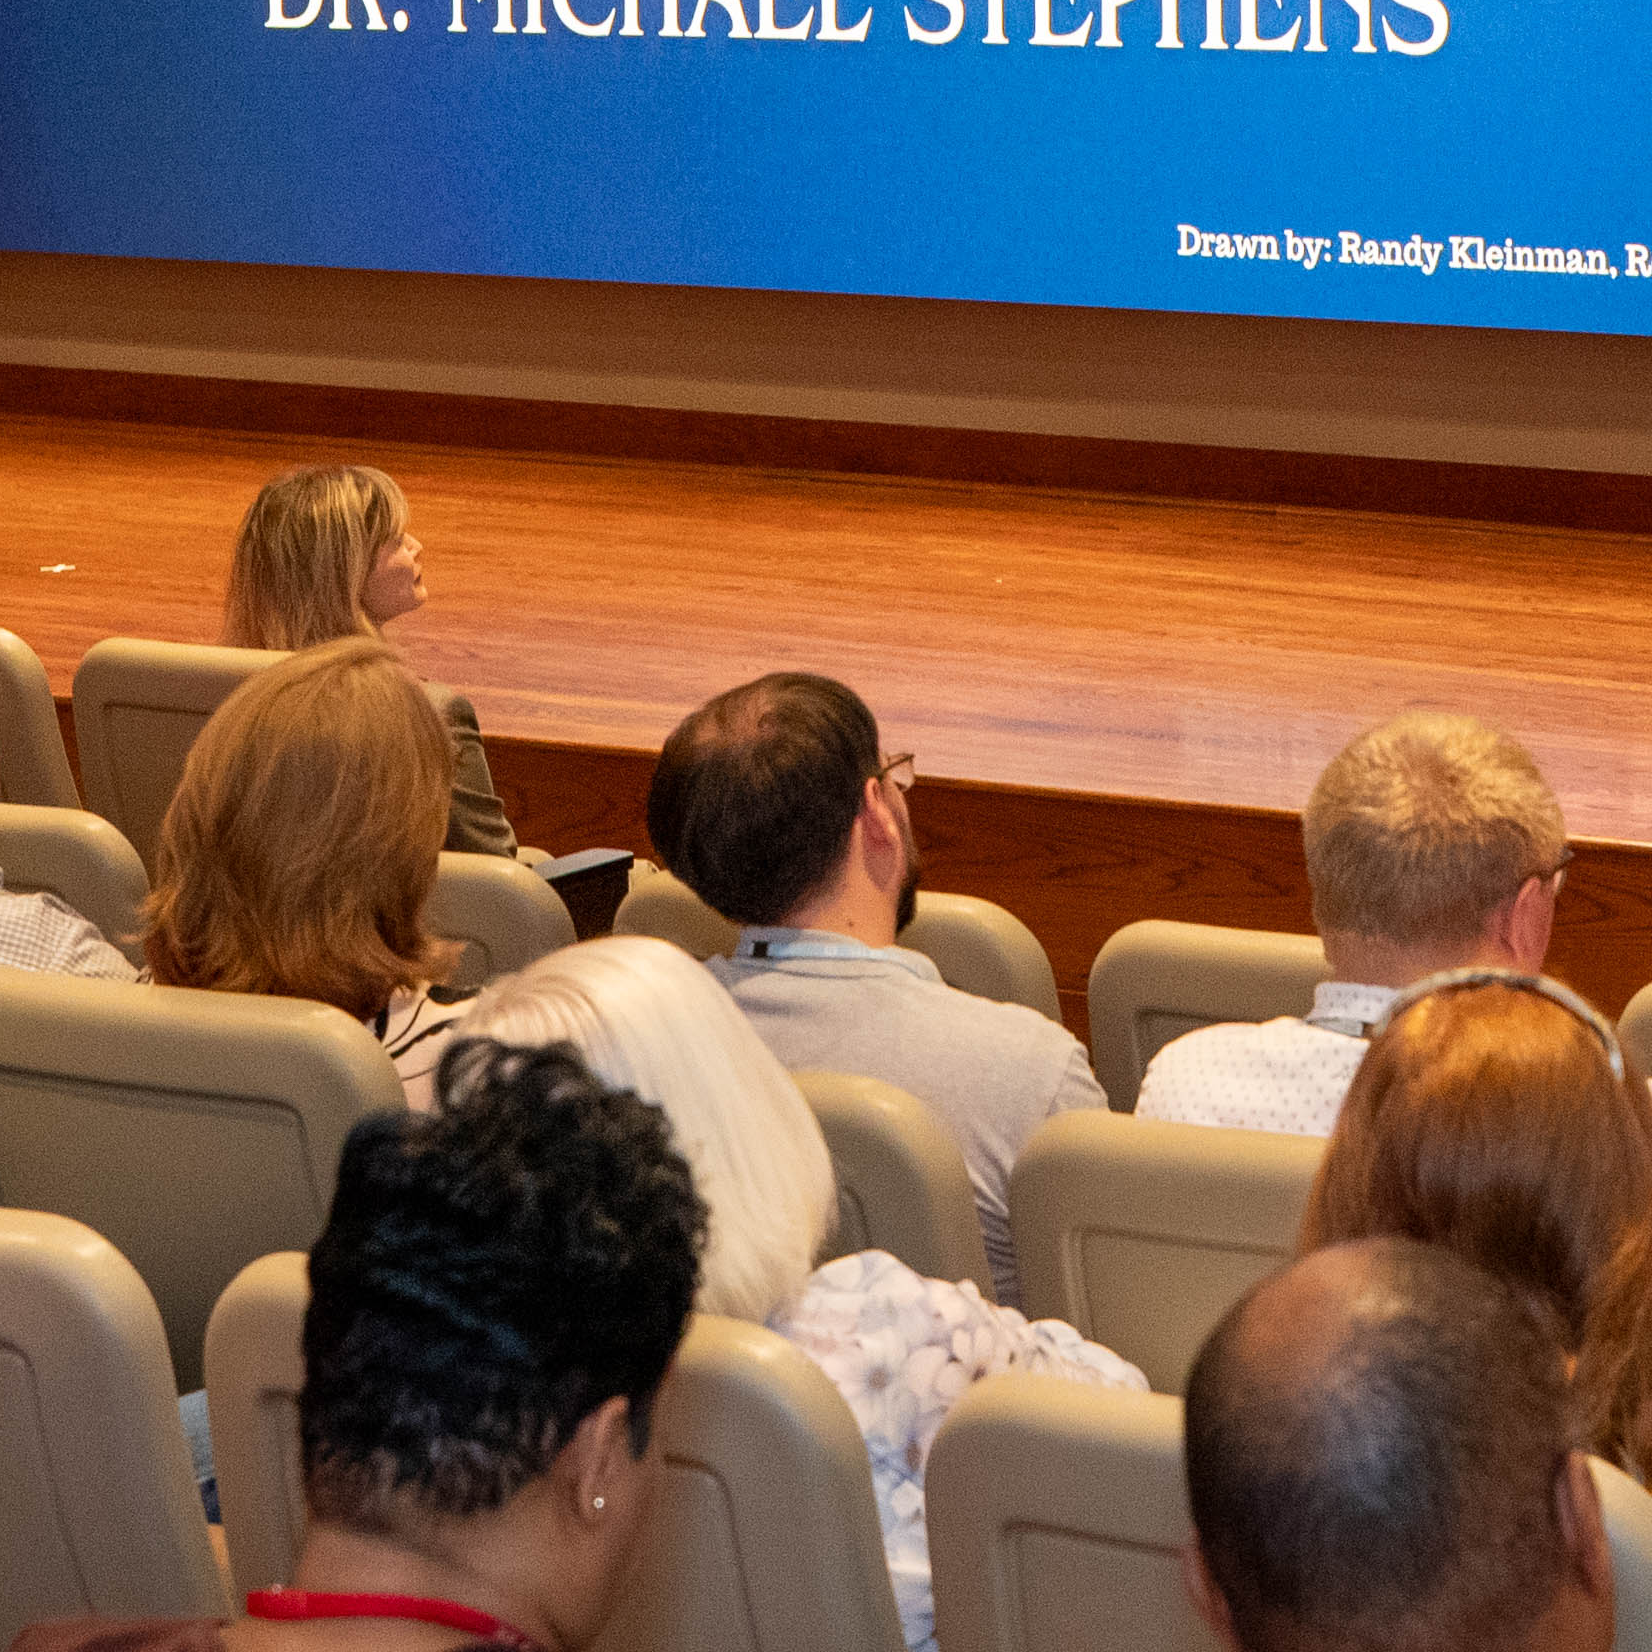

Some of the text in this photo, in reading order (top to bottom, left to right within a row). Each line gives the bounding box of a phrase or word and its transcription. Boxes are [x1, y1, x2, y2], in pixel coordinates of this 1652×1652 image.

[1176, 223, 1280, 261] Drawn
[1283, 229, 1332, 270] by:
[1338, 231, 1443, 276] Randy
[1448, 235, 1619, 280] Kleinman,
